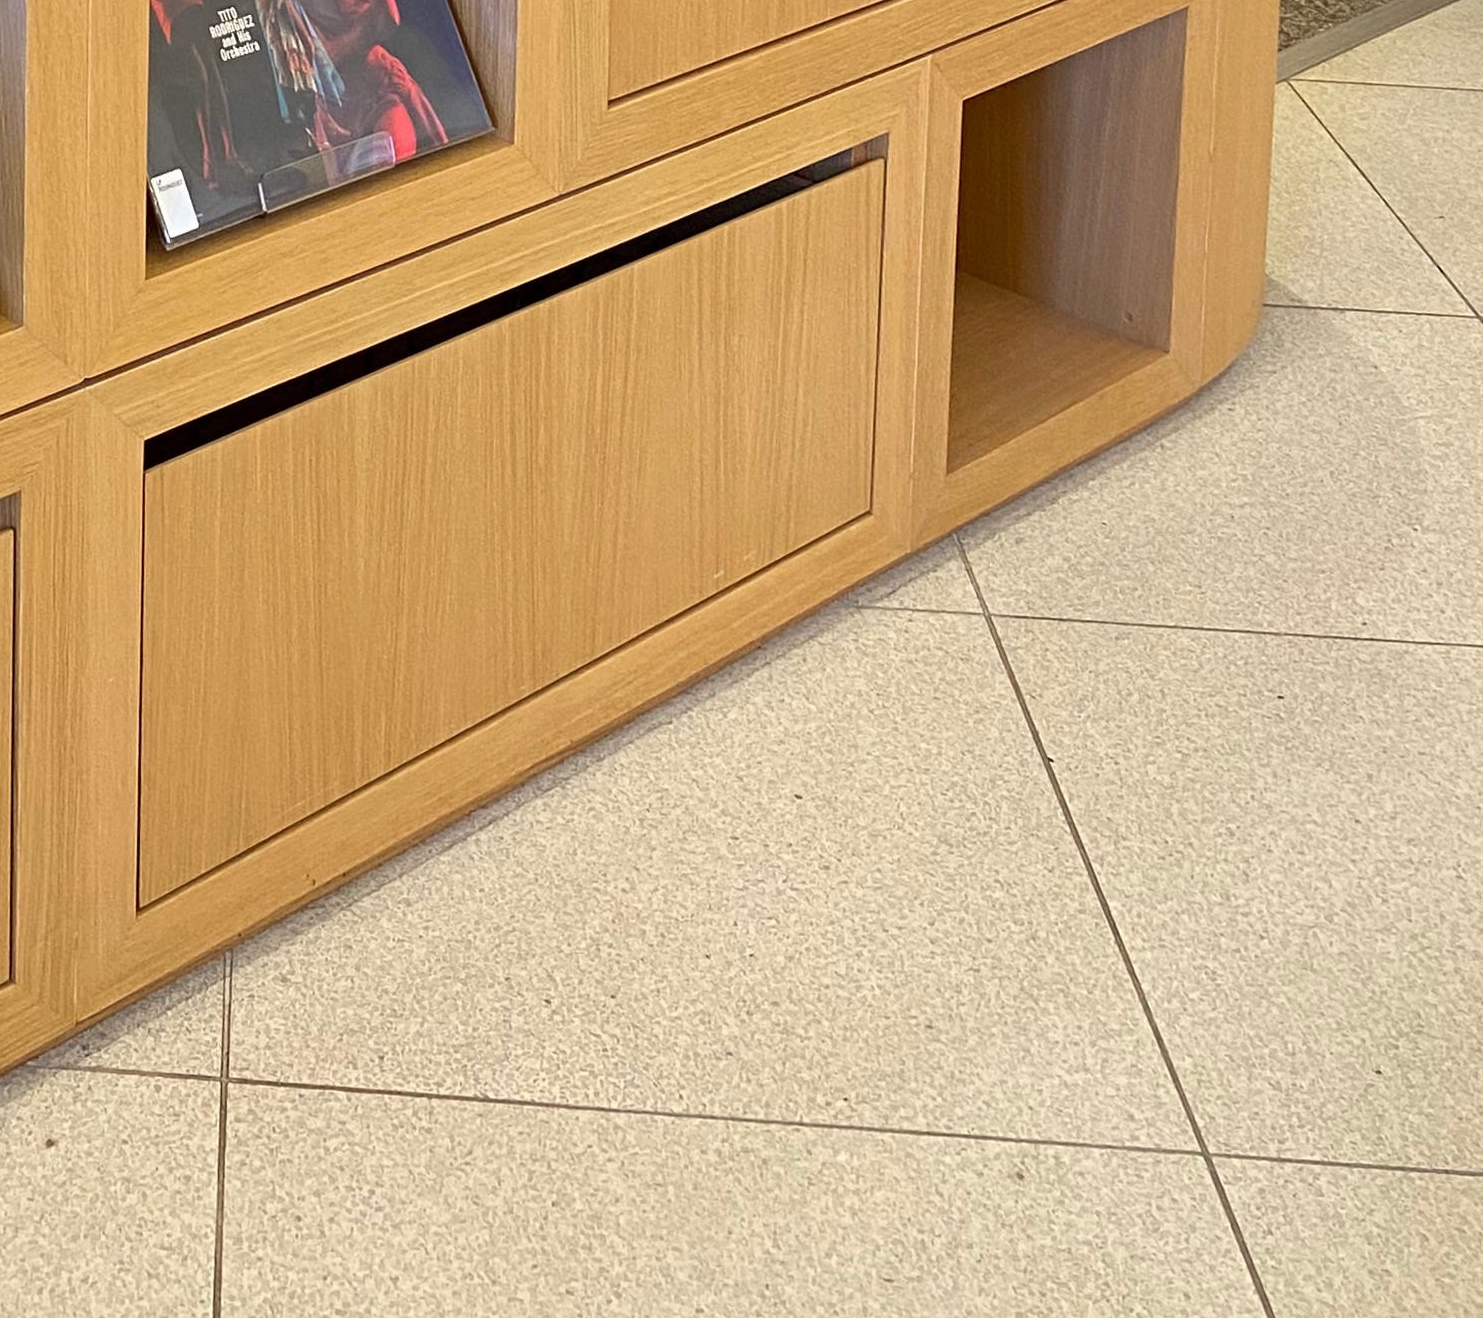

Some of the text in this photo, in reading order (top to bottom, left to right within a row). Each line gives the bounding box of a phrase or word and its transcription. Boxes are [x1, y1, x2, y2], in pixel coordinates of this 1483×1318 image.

[217, 7, 238, 22] TITO
[209, 15, 255, 38] RODRIGUEZ
[222, 33, 237, 48] and
[220, 41, 260, 61] Orchestra
